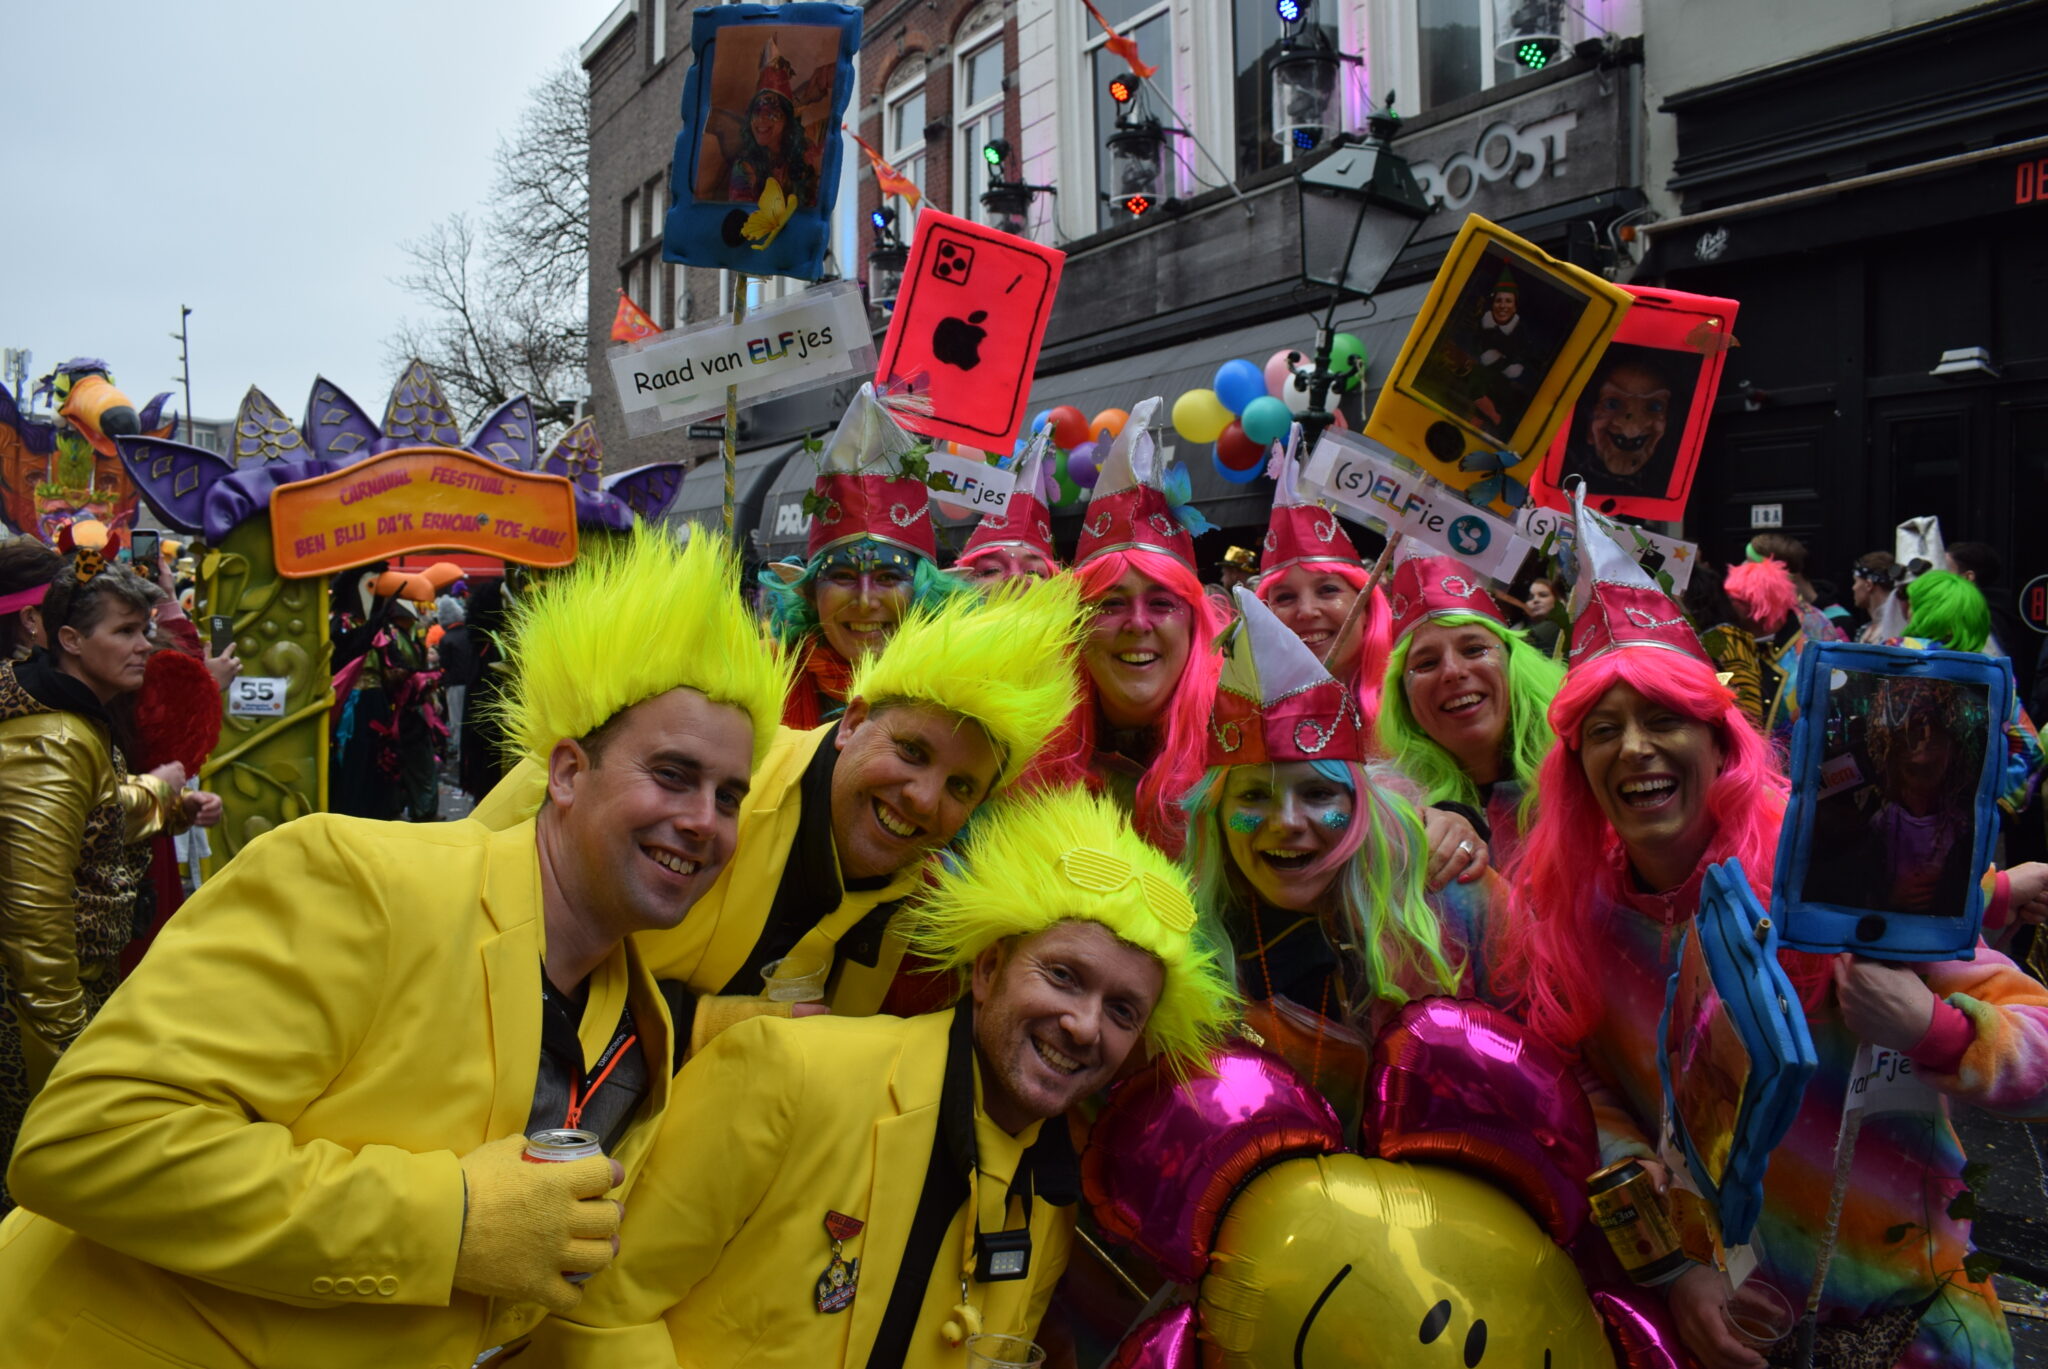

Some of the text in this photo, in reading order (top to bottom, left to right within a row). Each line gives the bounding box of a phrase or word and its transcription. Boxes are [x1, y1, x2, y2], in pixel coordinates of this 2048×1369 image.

[634, 326, 833, 394] Raad van ELFjes
[340, 468, 412, 506] CARNAVAL
[1335, 461, 1445, 533] (s)ELFie
[294, 533, 326, 559] BEN
[333, 522, 366, 547] BLIJ
[377, 513, 413, 536] DA'K
[494, 519, 567, 549] TOE-KAN!
[240, 682, 274, 701] 55
[597, 1033, 627, 1068] NORDBERG
